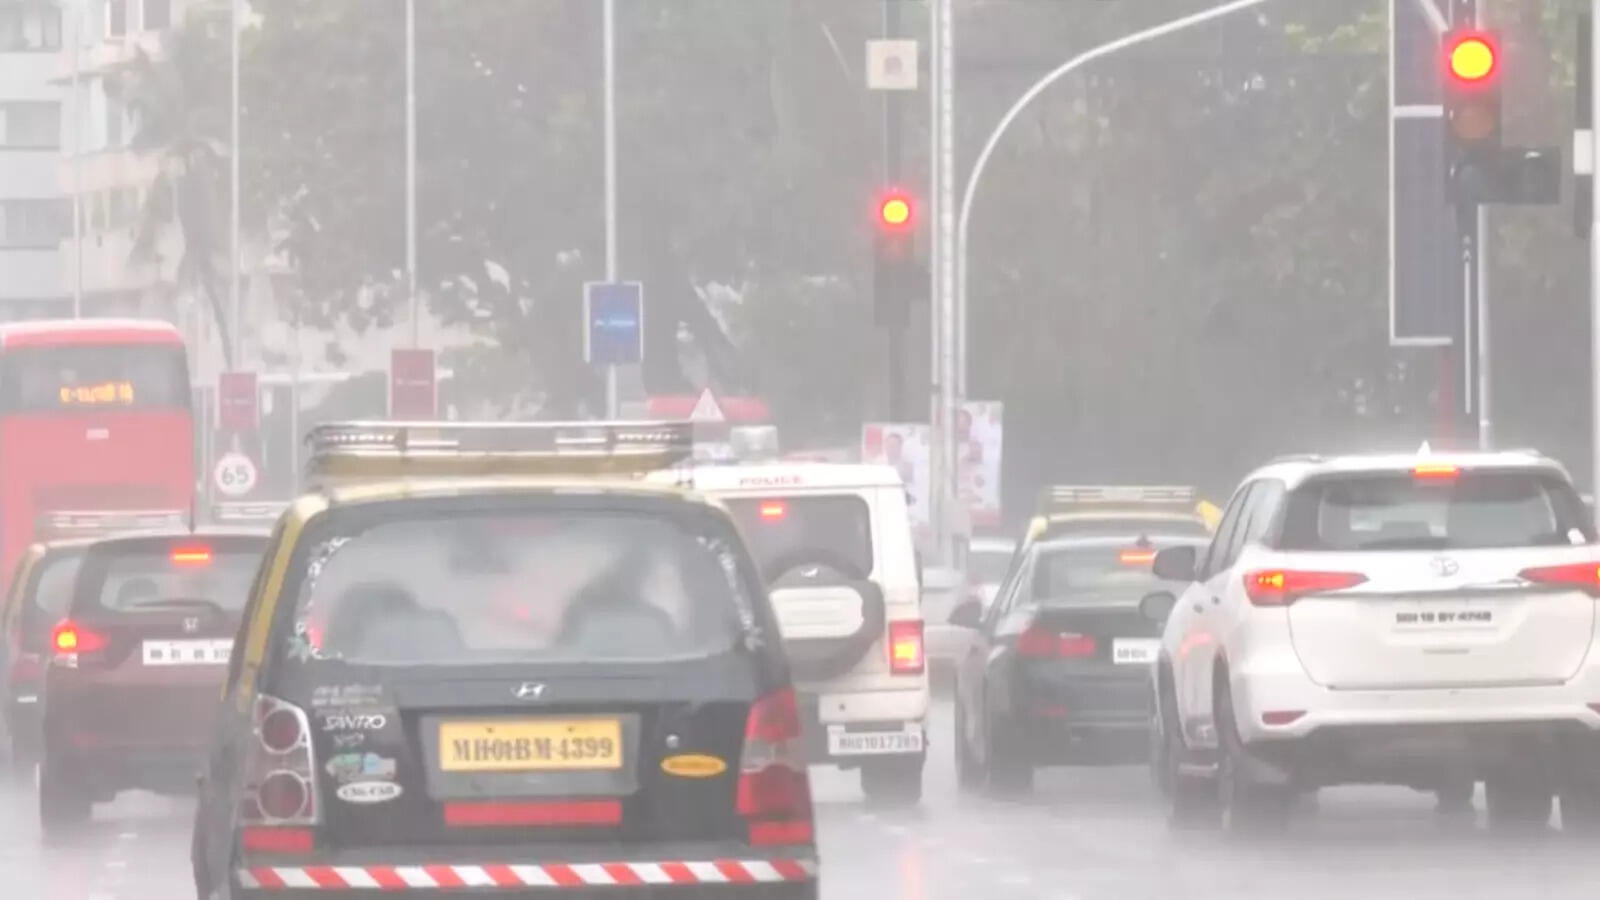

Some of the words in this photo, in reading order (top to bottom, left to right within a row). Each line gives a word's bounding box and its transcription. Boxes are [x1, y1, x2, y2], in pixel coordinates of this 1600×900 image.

[221, 465, 250, 485] 65
[740, 475, 803, 486] POLICE
[322, 714, 386, 731] SANTRO
